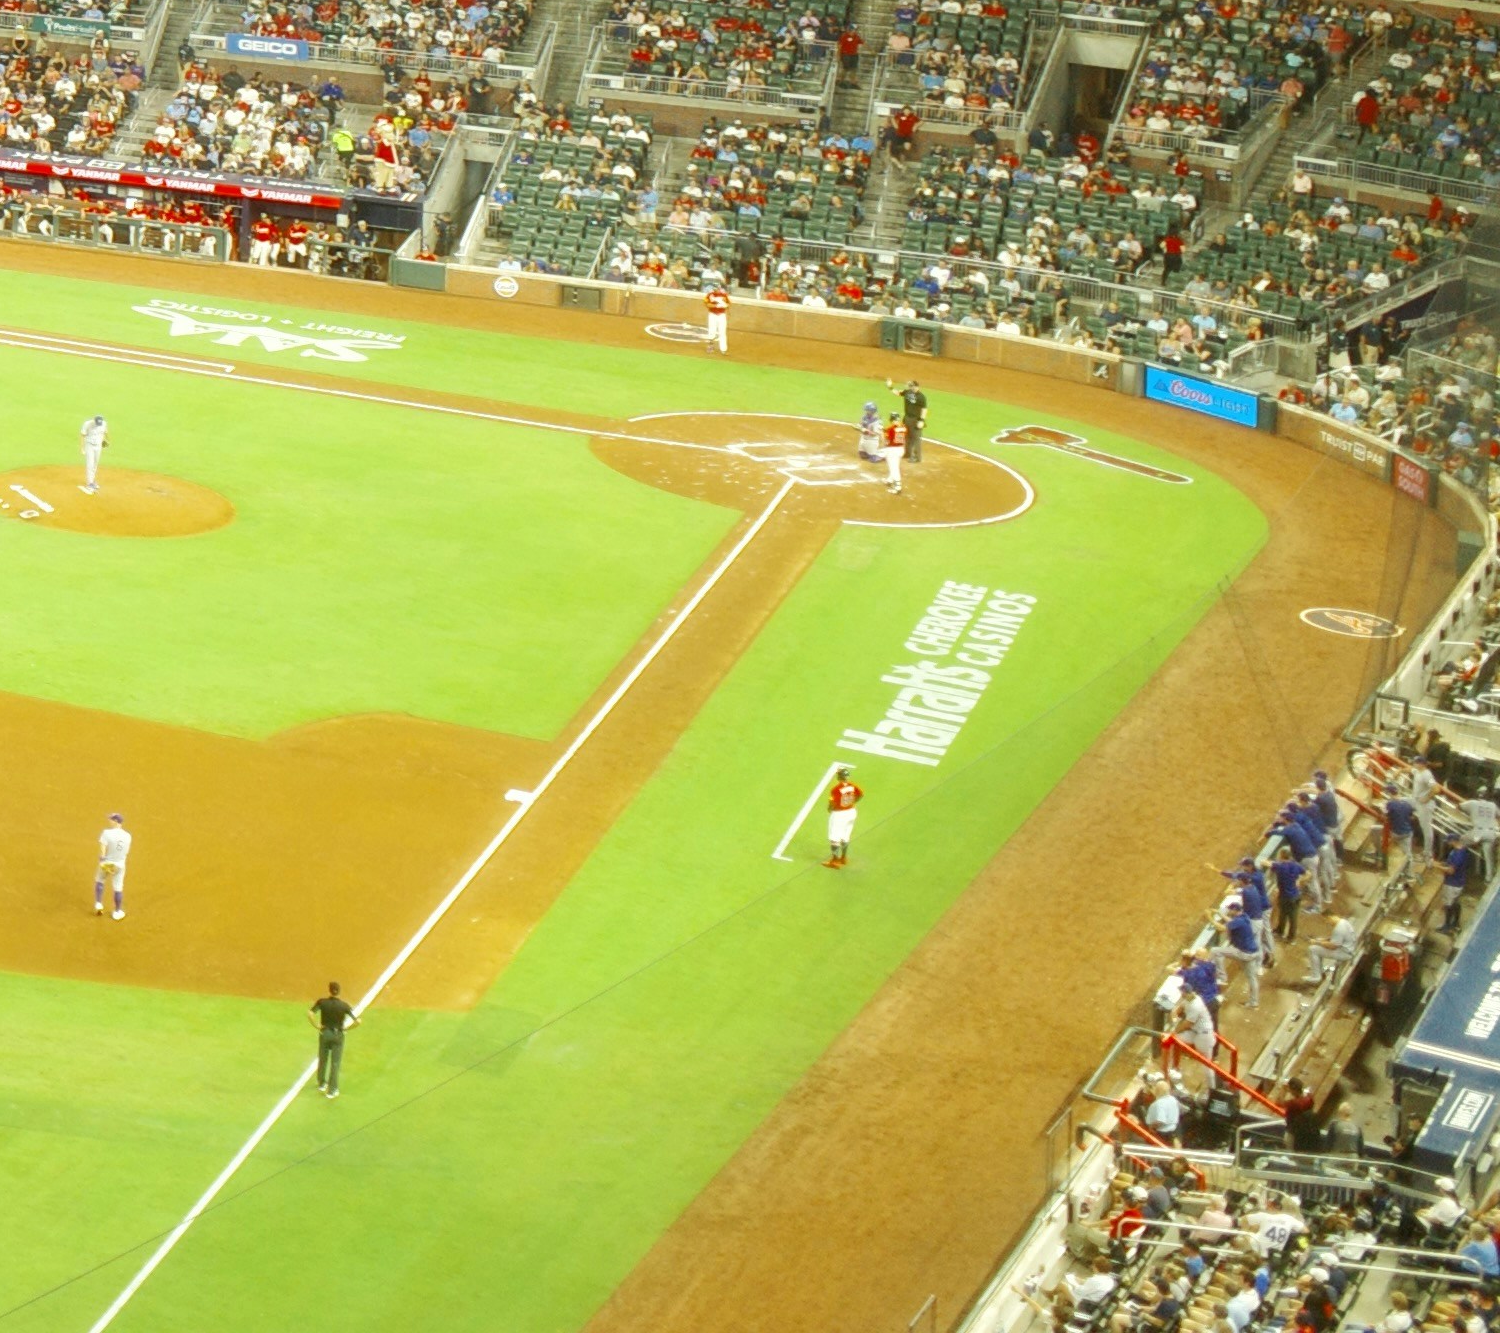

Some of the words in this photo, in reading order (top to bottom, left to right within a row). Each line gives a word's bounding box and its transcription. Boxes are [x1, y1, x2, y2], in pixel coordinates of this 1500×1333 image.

[237, 39, 297, 55] GEICO
[70, 169, 120, 181] YANMAR
[165, 179, 215, 192] YANMAR
[262, 190, 311, 203] YANMAR
[149, 299, 270, 323] LOGISTICS
[131, 305, 402, 362] SAIA
[301, 323, 406, 342] FREIGHT
[1169, 379, 1214, 405] Coors
[1320, 431, 1355, 451] TRUIST
[904, 580, 987, 656] CHEROKEE
[957, 589, 1038, 668] CASINOS
[1265, 1225, 1288, 1243] 48
